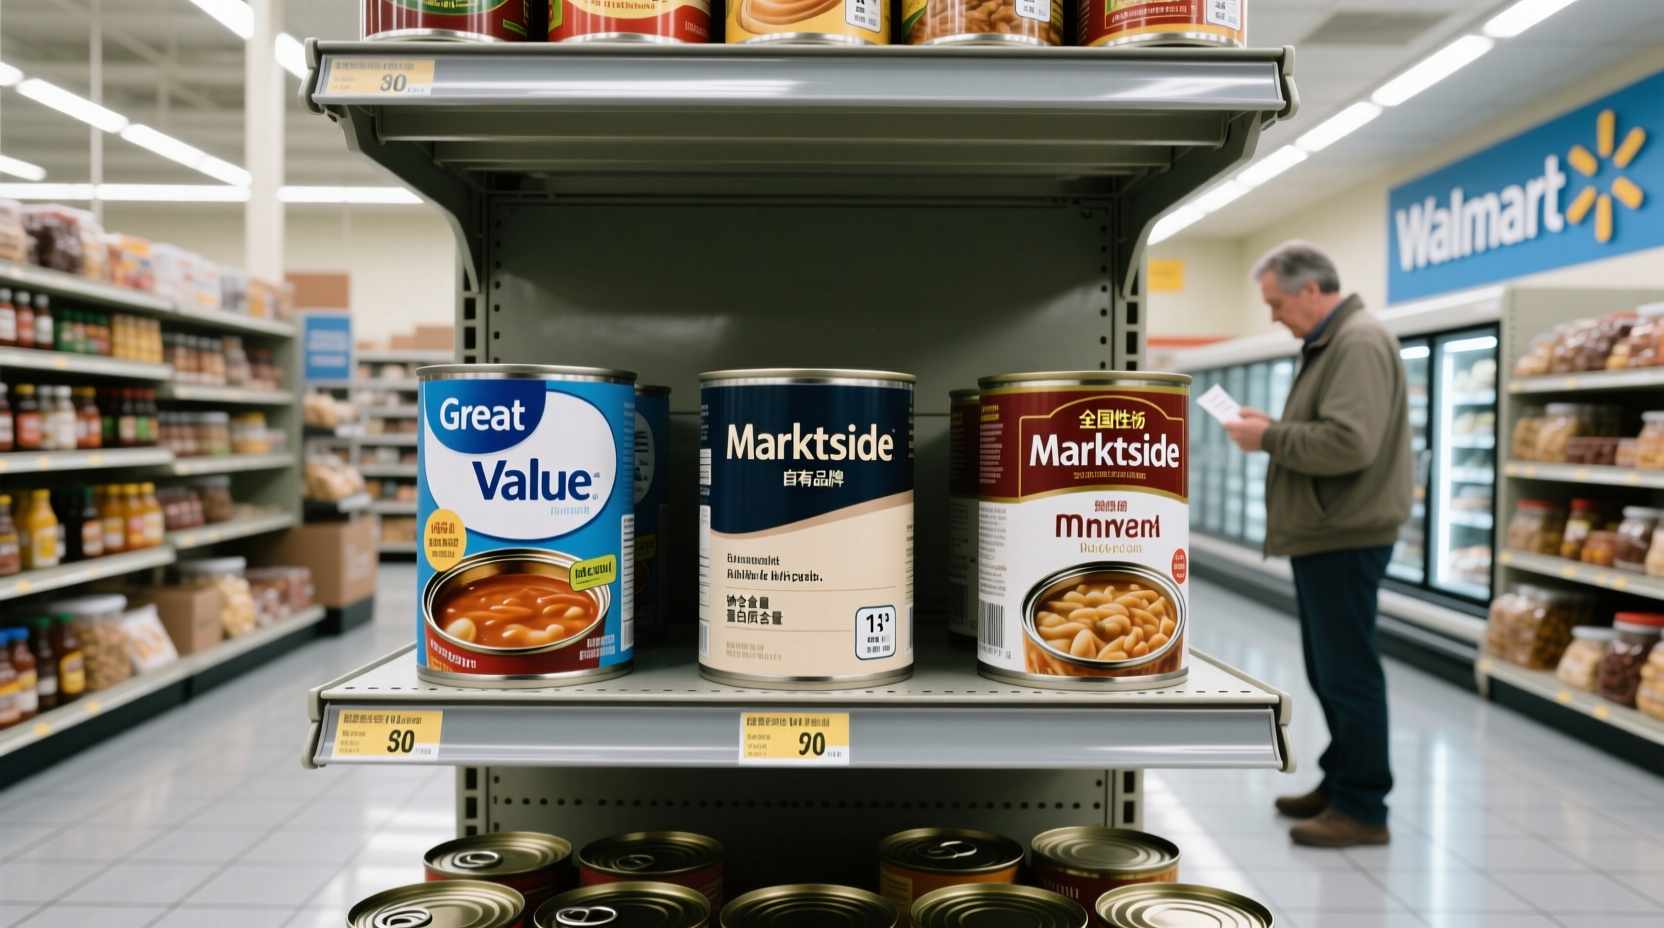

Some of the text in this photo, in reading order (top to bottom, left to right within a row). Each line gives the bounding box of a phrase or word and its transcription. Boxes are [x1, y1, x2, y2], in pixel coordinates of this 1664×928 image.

[1395, 154, 1566, 272] Walmart
[439, 397, 526, 431] Great
[726, 423, 893, 461] Marktside
[1030, 433, 1179, 468] Marktside
[472, 458, 592, 501] Value
[783, 469, 844, 488] 自有品牌
[799, 732, 826, 756] 90
